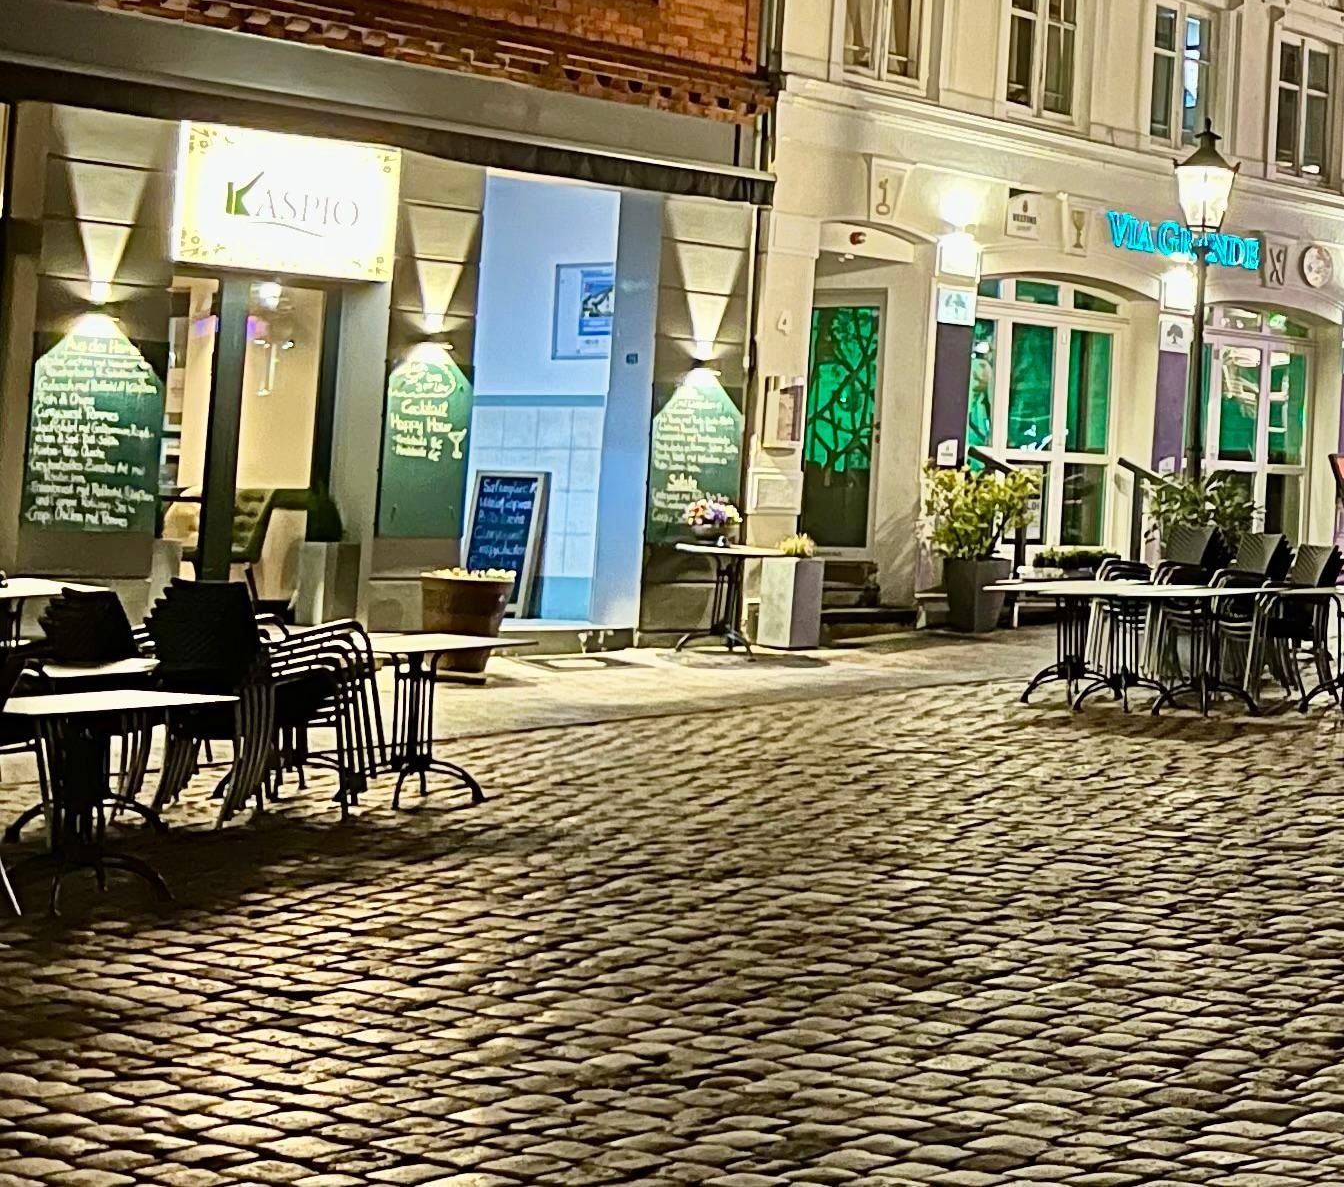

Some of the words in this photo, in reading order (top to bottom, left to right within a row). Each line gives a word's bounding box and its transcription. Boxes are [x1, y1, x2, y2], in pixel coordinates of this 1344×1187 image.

[226, 172, 358, 226] KASPIO
[1107, 210, 1154, 253] VIA
[1157, 220, 1260, 270] GRNDE
[390, 413, 424, 436] Happy
[427, 417, 453, 432] Hour
